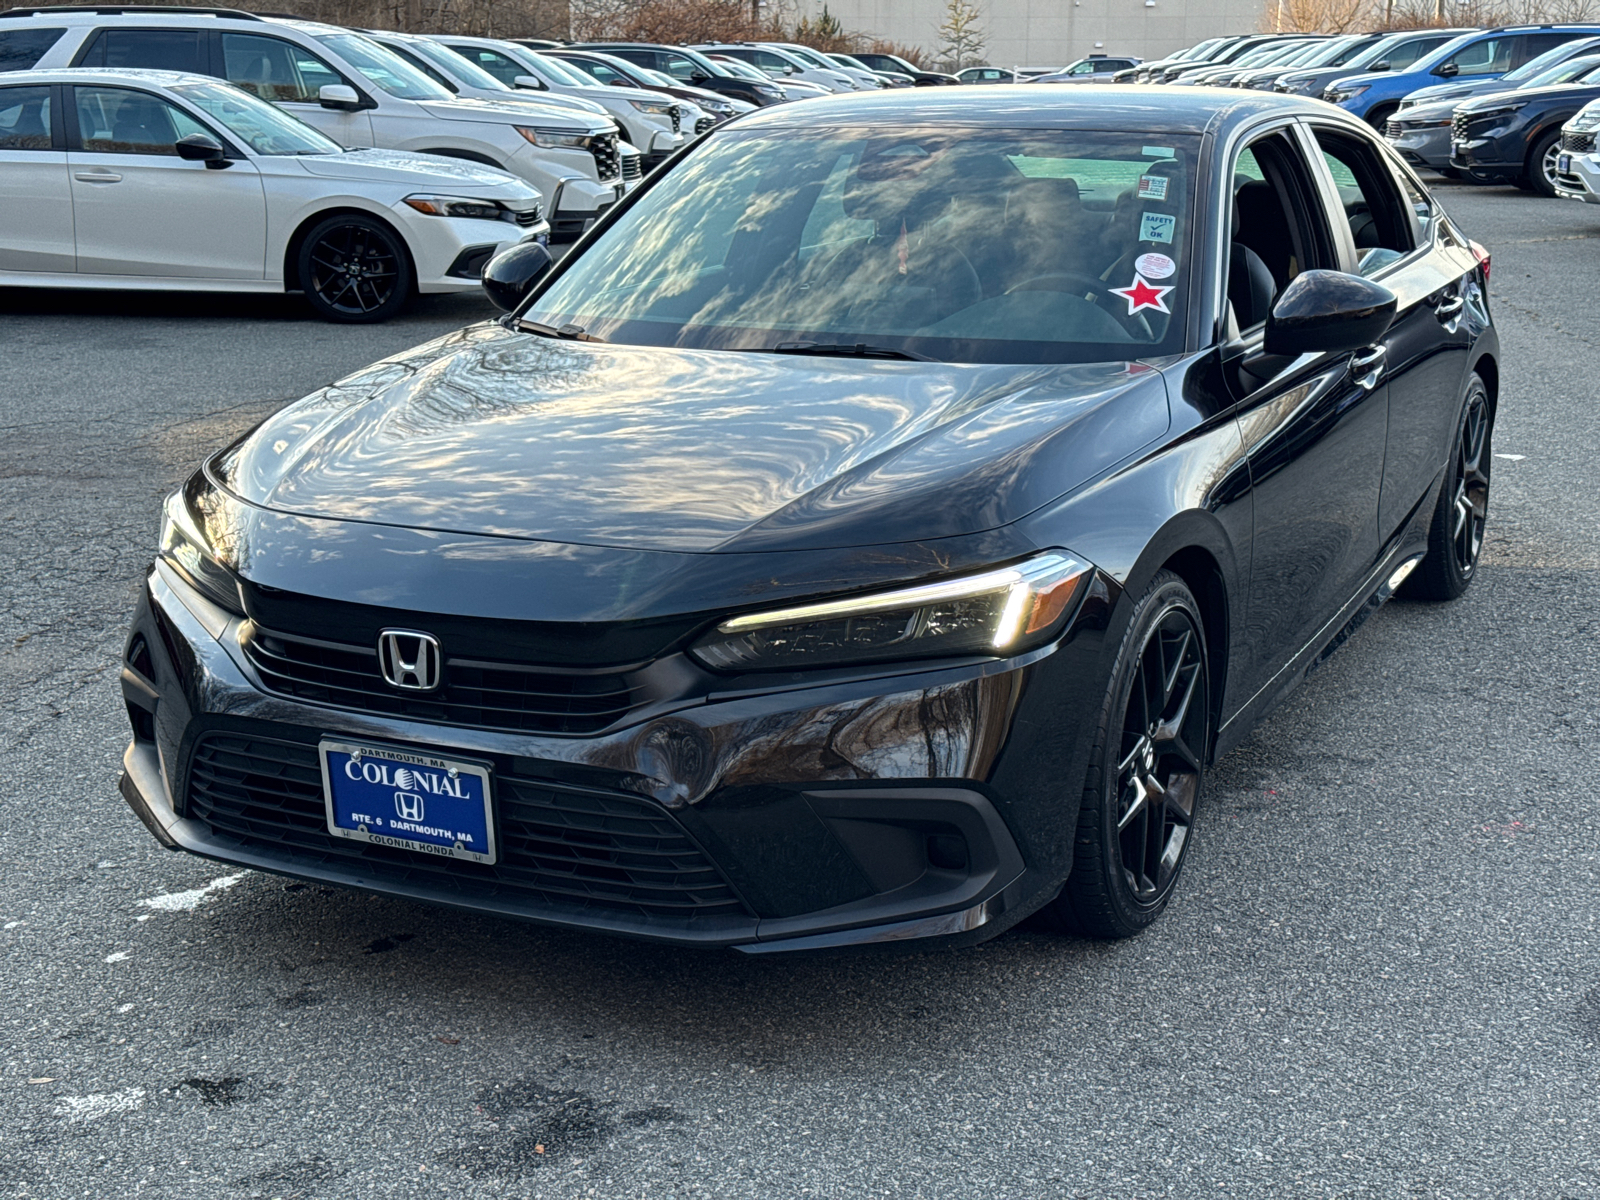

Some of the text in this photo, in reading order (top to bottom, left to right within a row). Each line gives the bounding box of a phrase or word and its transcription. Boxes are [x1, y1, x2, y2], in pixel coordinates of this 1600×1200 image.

[1146, 215, 1173, 224] SAFETY
[430, 760, 446, 768] MA
[345, 760, 470, 799] COLONIAL
[352, 813, 382, 826] RTE. 6
[390, 820, 473, 843] DARTMOUTH, MA
[369, 834, 455, 857] COLONIAL HONDA
